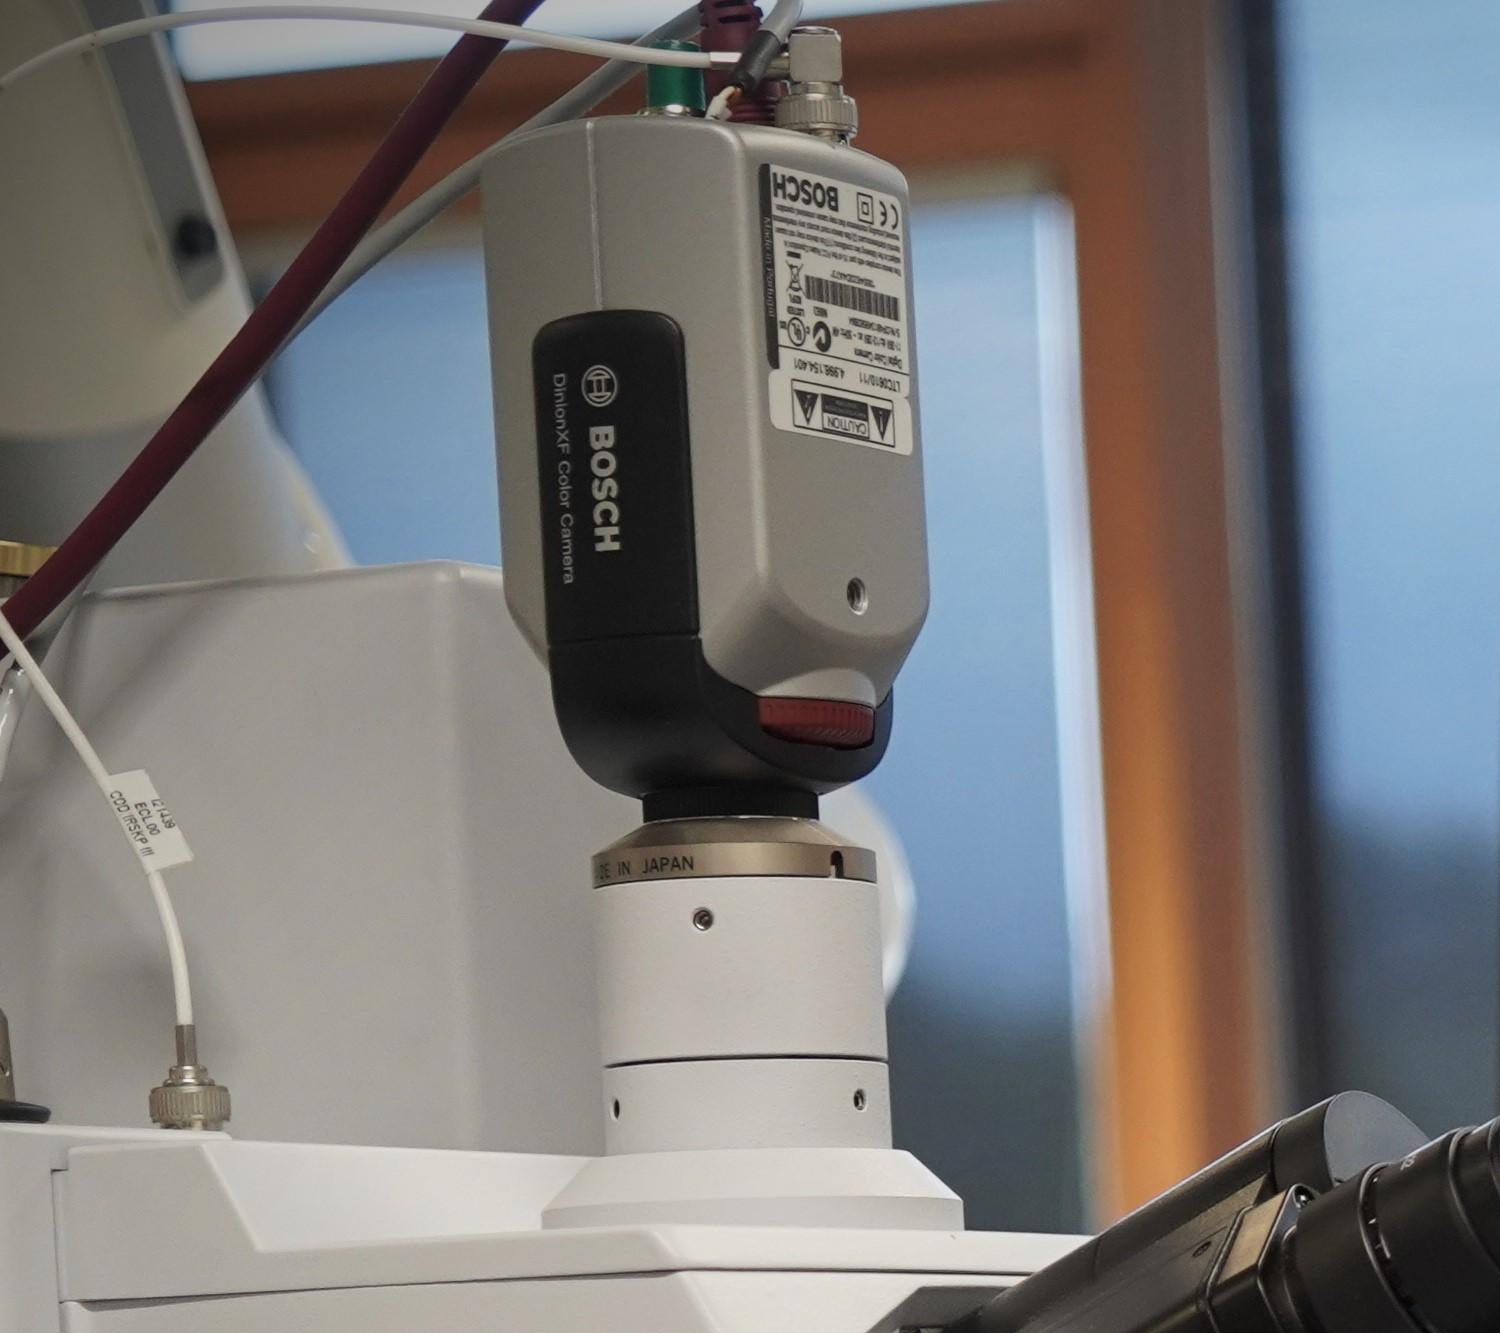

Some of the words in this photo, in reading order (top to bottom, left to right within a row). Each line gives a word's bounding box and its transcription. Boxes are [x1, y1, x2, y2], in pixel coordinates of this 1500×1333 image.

[772, 171, 839, 213] BOSCH
[552, 372, 570, 455] DinionXF
[826, 415, 868, 436] CAUTION
[557, 460, 573, 508] Color
[588, 424, 621, 552] BOSCH
[560, 512, 576, 585] Camera
[617, 860, 631, 876] IN
[641, 855, 695, 874] JAPAN
